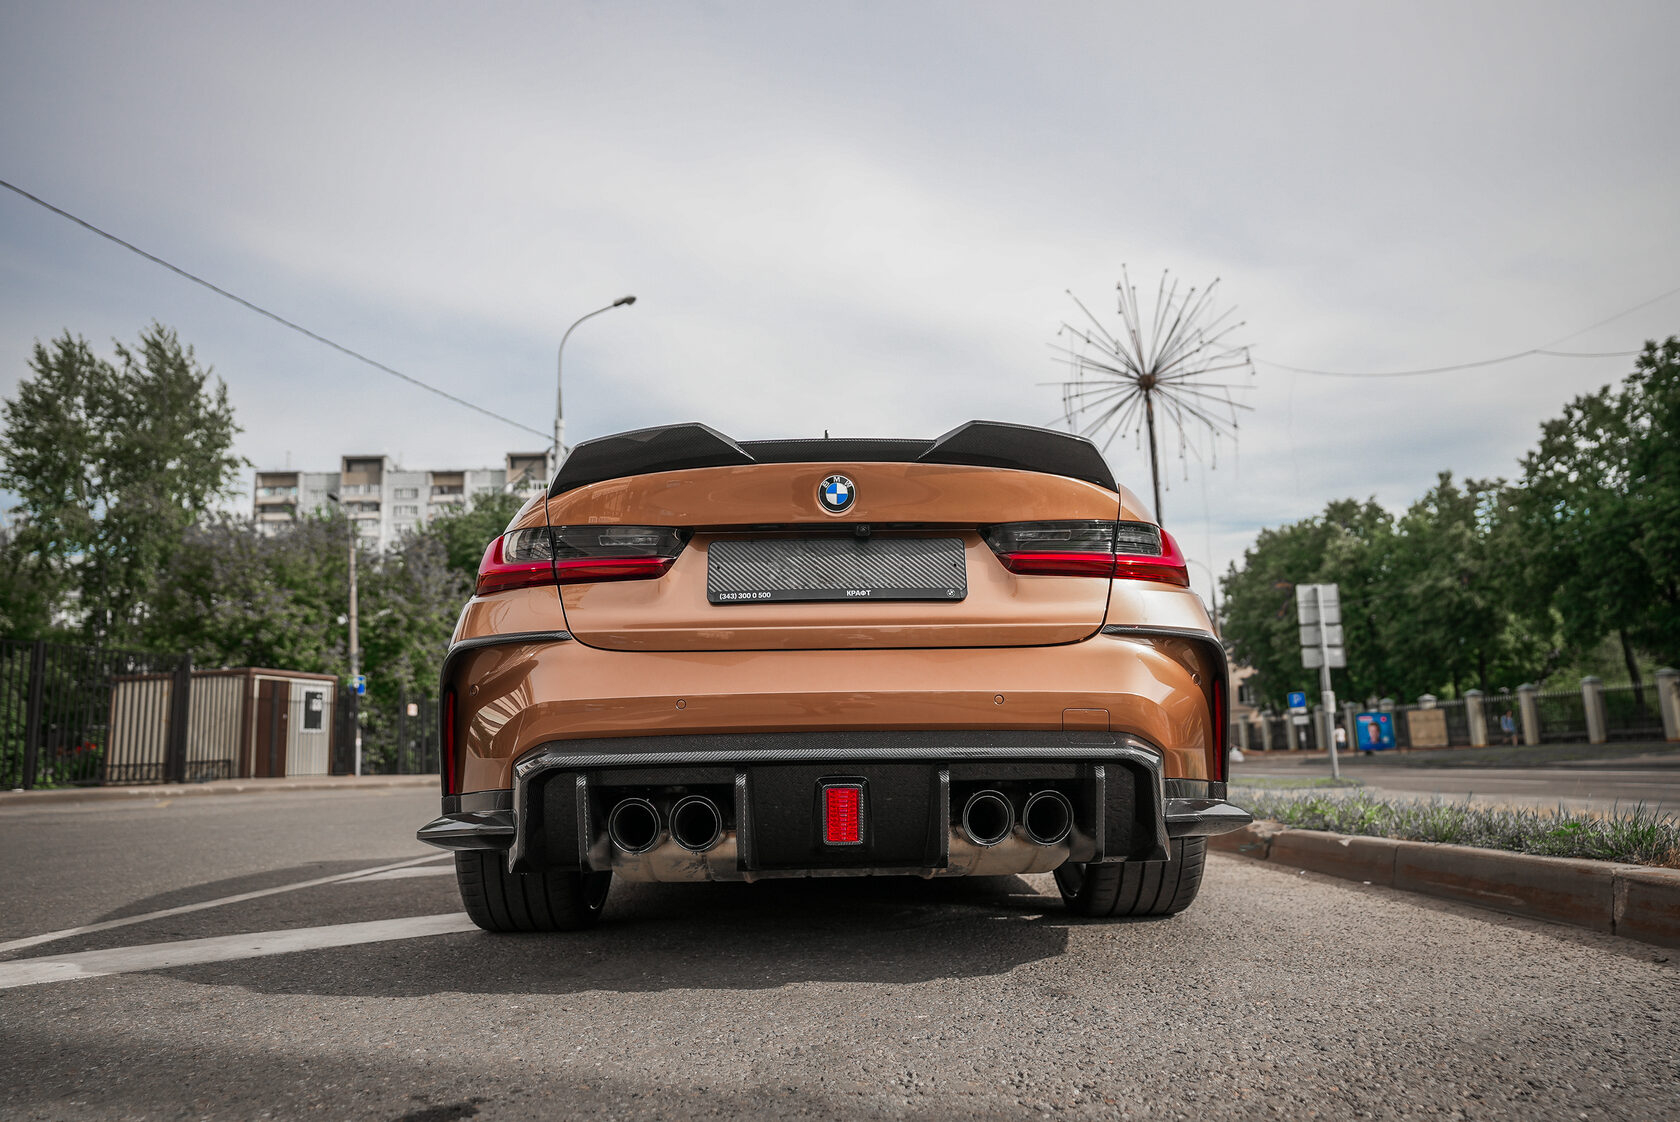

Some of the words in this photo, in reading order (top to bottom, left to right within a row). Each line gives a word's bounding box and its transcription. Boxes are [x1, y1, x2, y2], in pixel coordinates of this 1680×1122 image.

[822, 476, 852, 488] BMW
[719, 592, 737, 600] (343)
[758, 591, 771, 599] 500
[846, 589, 871, 597] КРАФТ
